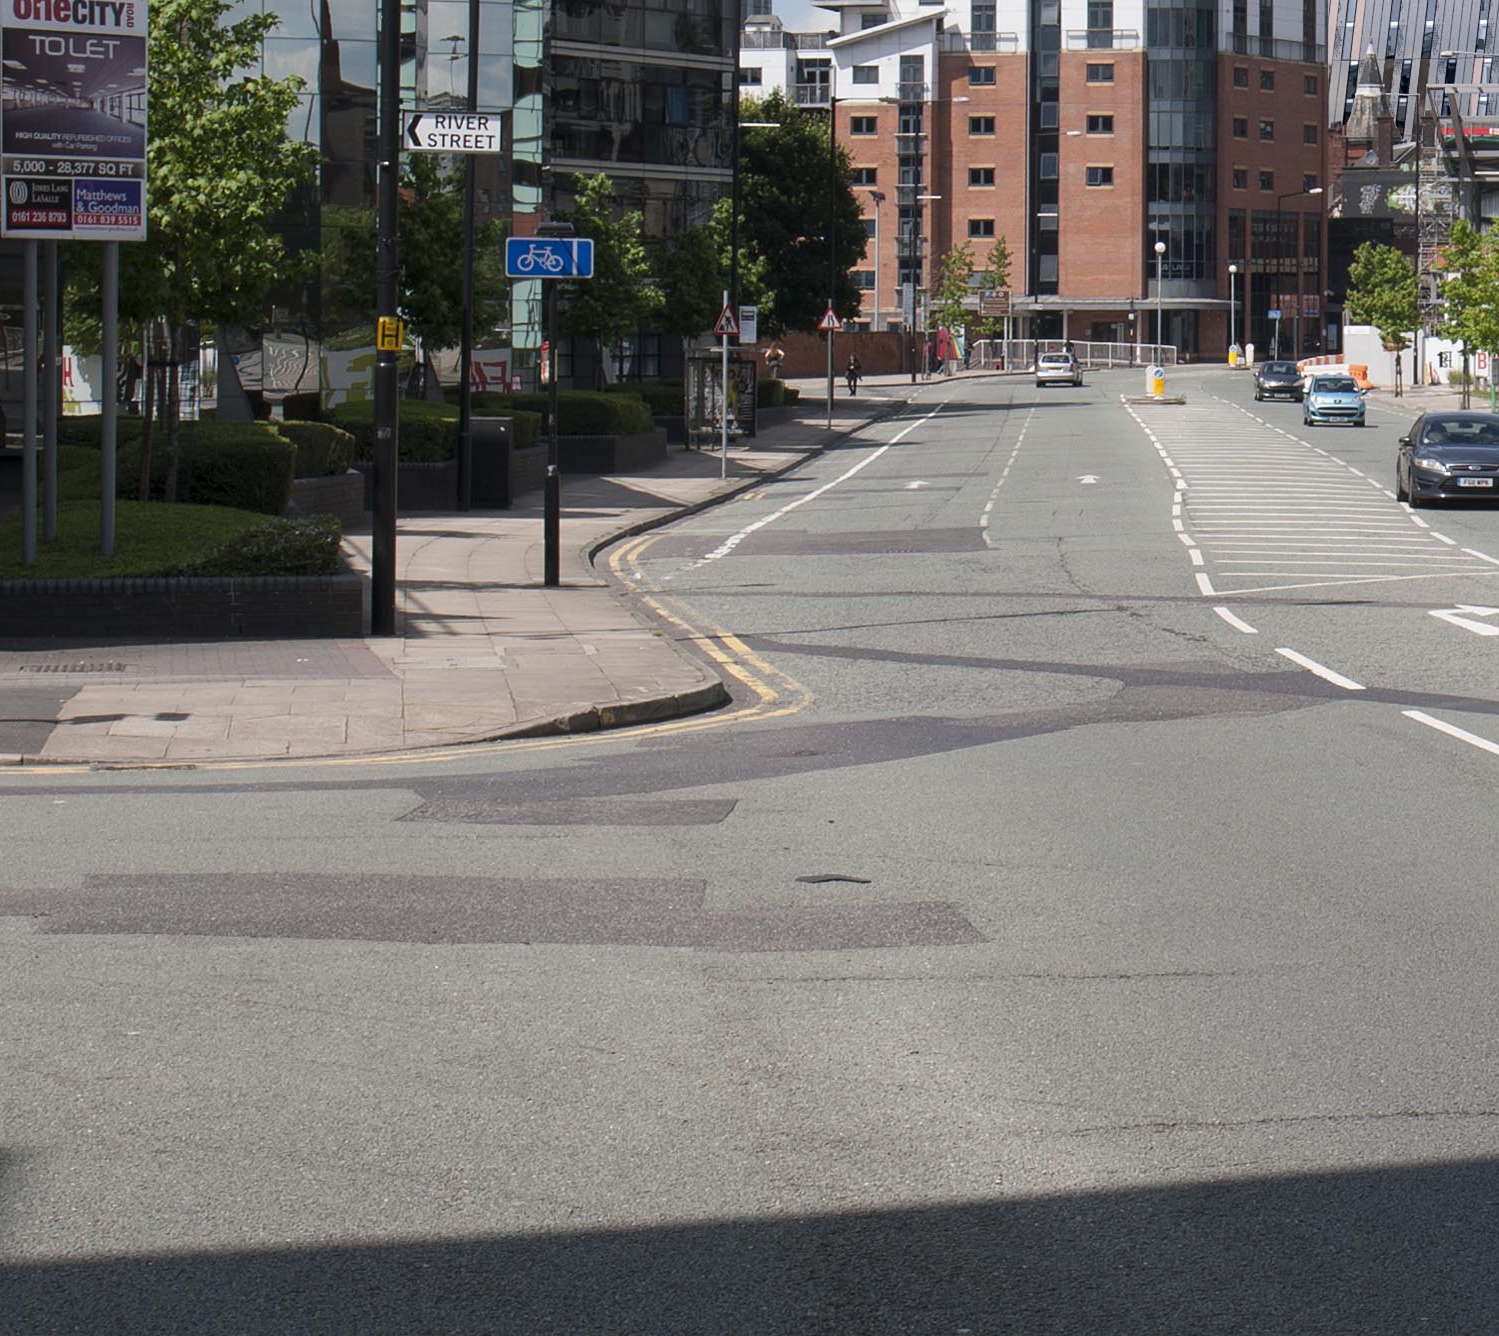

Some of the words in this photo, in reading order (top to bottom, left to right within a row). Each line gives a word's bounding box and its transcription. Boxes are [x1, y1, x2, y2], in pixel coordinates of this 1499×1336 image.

[126, 2, 135, 28] ROAD
[28, 34, 66, 56] TO
[69, 38, 120, 60] LET
[435, 114, 489, 131] RIVER
[427, 133, 495, 149] STREET
[13, 160, 45, 173] 5,000
[57, 162, 95, 175] 28,377
[98, 163, 116, 175] SQ
[119, 164, 134, 175] FT
[76, 188, 127, 201] Matthews
[76, 202, 85, 212] &
[88, 202, 139, 214] Goodman
[12, 211, 30, 223] 0161
[77, 215, 97, 224] 0161
[118, 216, 138, 225] 5515
